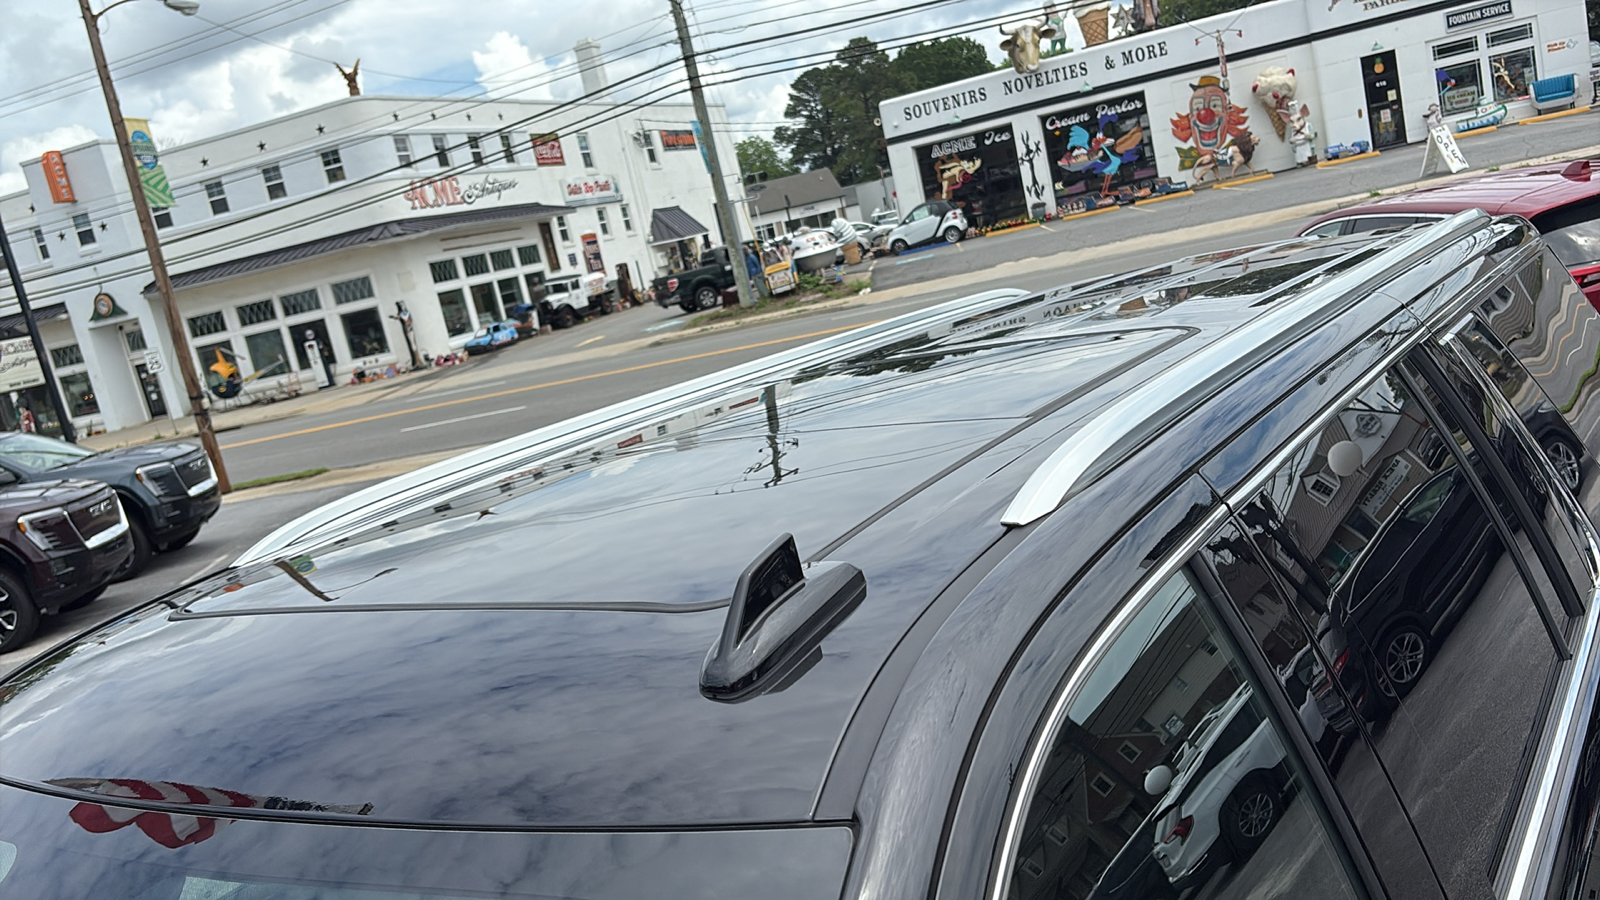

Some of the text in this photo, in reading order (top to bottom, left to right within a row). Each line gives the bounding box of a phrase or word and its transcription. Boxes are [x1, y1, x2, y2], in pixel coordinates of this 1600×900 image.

[1448, 3, 1509, 26] FOUNTAIN SERVICE
[904, 41, 1169, 122] SOUVENIRS NOVELTIES & MORE
[1046, 99, 1144, 131] Cream Parlor
[930, 130, 1012, 159] ACME Ice
[51, 153, 69, 198] ACME
[404, 175, 464, 210] ACME
[149, 360, 162, 371] 25
